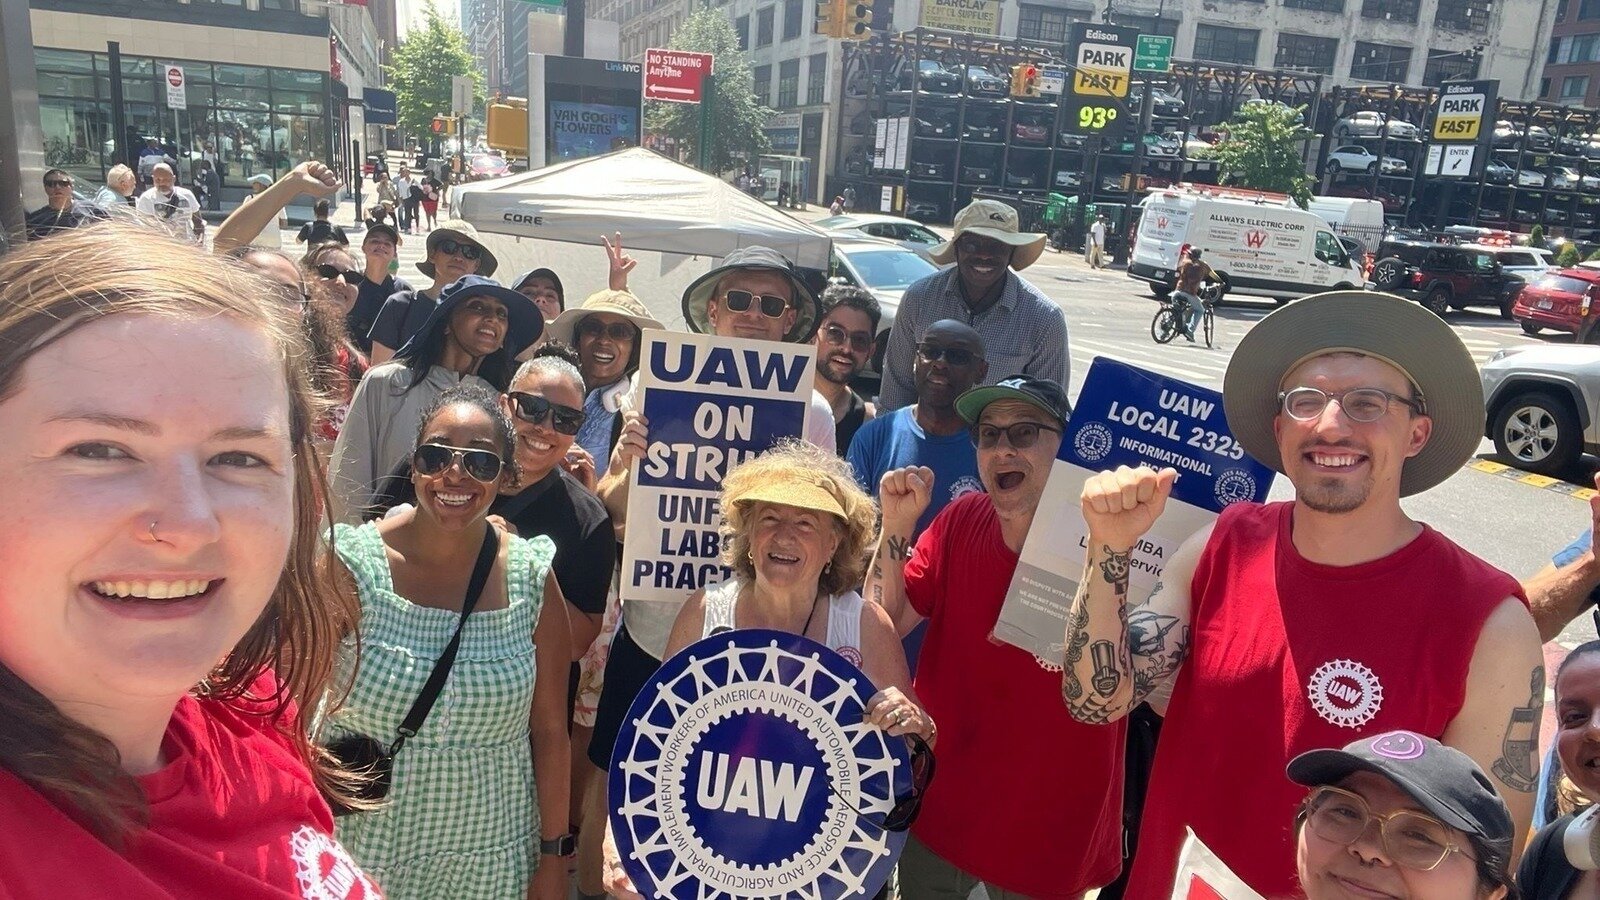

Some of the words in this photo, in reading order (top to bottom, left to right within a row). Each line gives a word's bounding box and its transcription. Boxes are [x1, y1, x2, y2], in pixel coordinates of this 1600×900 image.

[936, 0, 987, 10] BARCLAY
[1086, 29, 1118, 41] Edison
[605, 62, 640, 73] LinkNYC
[650, 54, 661, 65] NO
[663, 56, 702, 68] STANDING
[1083, 50, 1126, 67] PARK
[1079, 72, 1122, 90] FAST
[1447, 85, 1474, 94] Edison
[1443, 99, 1481, 113] PARK
[553, 110, 579, 121] VAN
[581, 111, 628, 125] GOGH'S
[554, 121, 612, 135] FLOWERS
[1439, 120, 1476, 133] FAST
[503, 213, 543, 226] CORE
[1210, 214, 1245, 224] ALLWAYS
[1247, 219, 1283, 229] ELECTRIC
[649, 341, 810, 394] UAW
[1158, 388, 1215, 422] UAW
[693, 401, 754, 441] ON
[1107, 401, 1182, 442] LOCAL
[1187, 427, 1245, 461] 2325
[644, 441, 768, 483] STRI
[1119, 436, 1213, 477] INFORMATIONAL
[658, 494, 721, 525] UNF
[661, 528, 729, 559] LAB
[1134, 539, 1163, 558] MBA
[633, 559, 735, 590] PRACT
[713, 688, 766, 709] AMERICA
[1328, 680, 1362, 704] UAW
[695, 703, 710, 719] OF
[770, 692, 814, 718] UNITED
[663, 717, 697, 773] WORKERS
[813, 717, 851, 797] AUTOMOBILE
[696, 750, 815, 822] UAW
[661, 775, 689, 851] IMPLEMENT
[805, 803, 849, 870] AEROSPACE
[687, 849, 774, 889] AGRICULTURAL
[778, 865, 805, 885] AND
